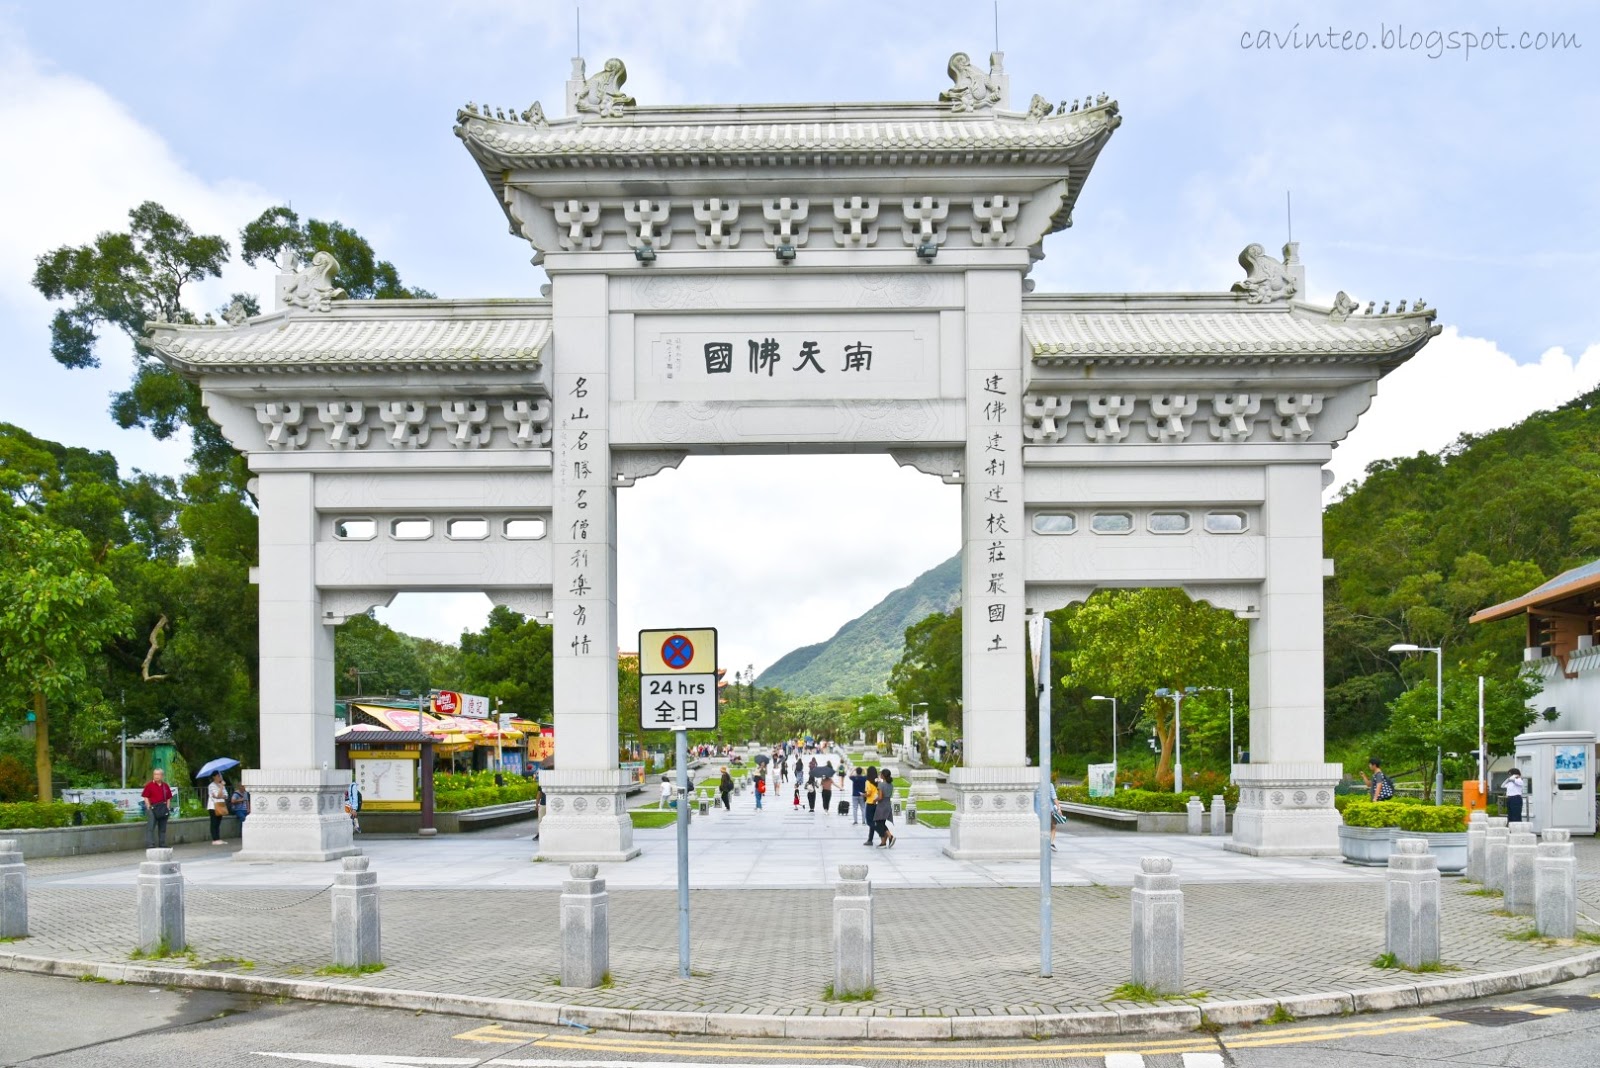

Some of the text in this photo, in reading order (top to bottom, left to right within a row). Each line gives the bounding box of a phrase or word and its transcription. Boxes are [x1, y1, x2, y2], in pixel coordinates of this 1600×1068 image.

[649, 680, 705, 695] 24 hrs
[654, 700, 698, 722] 全日
